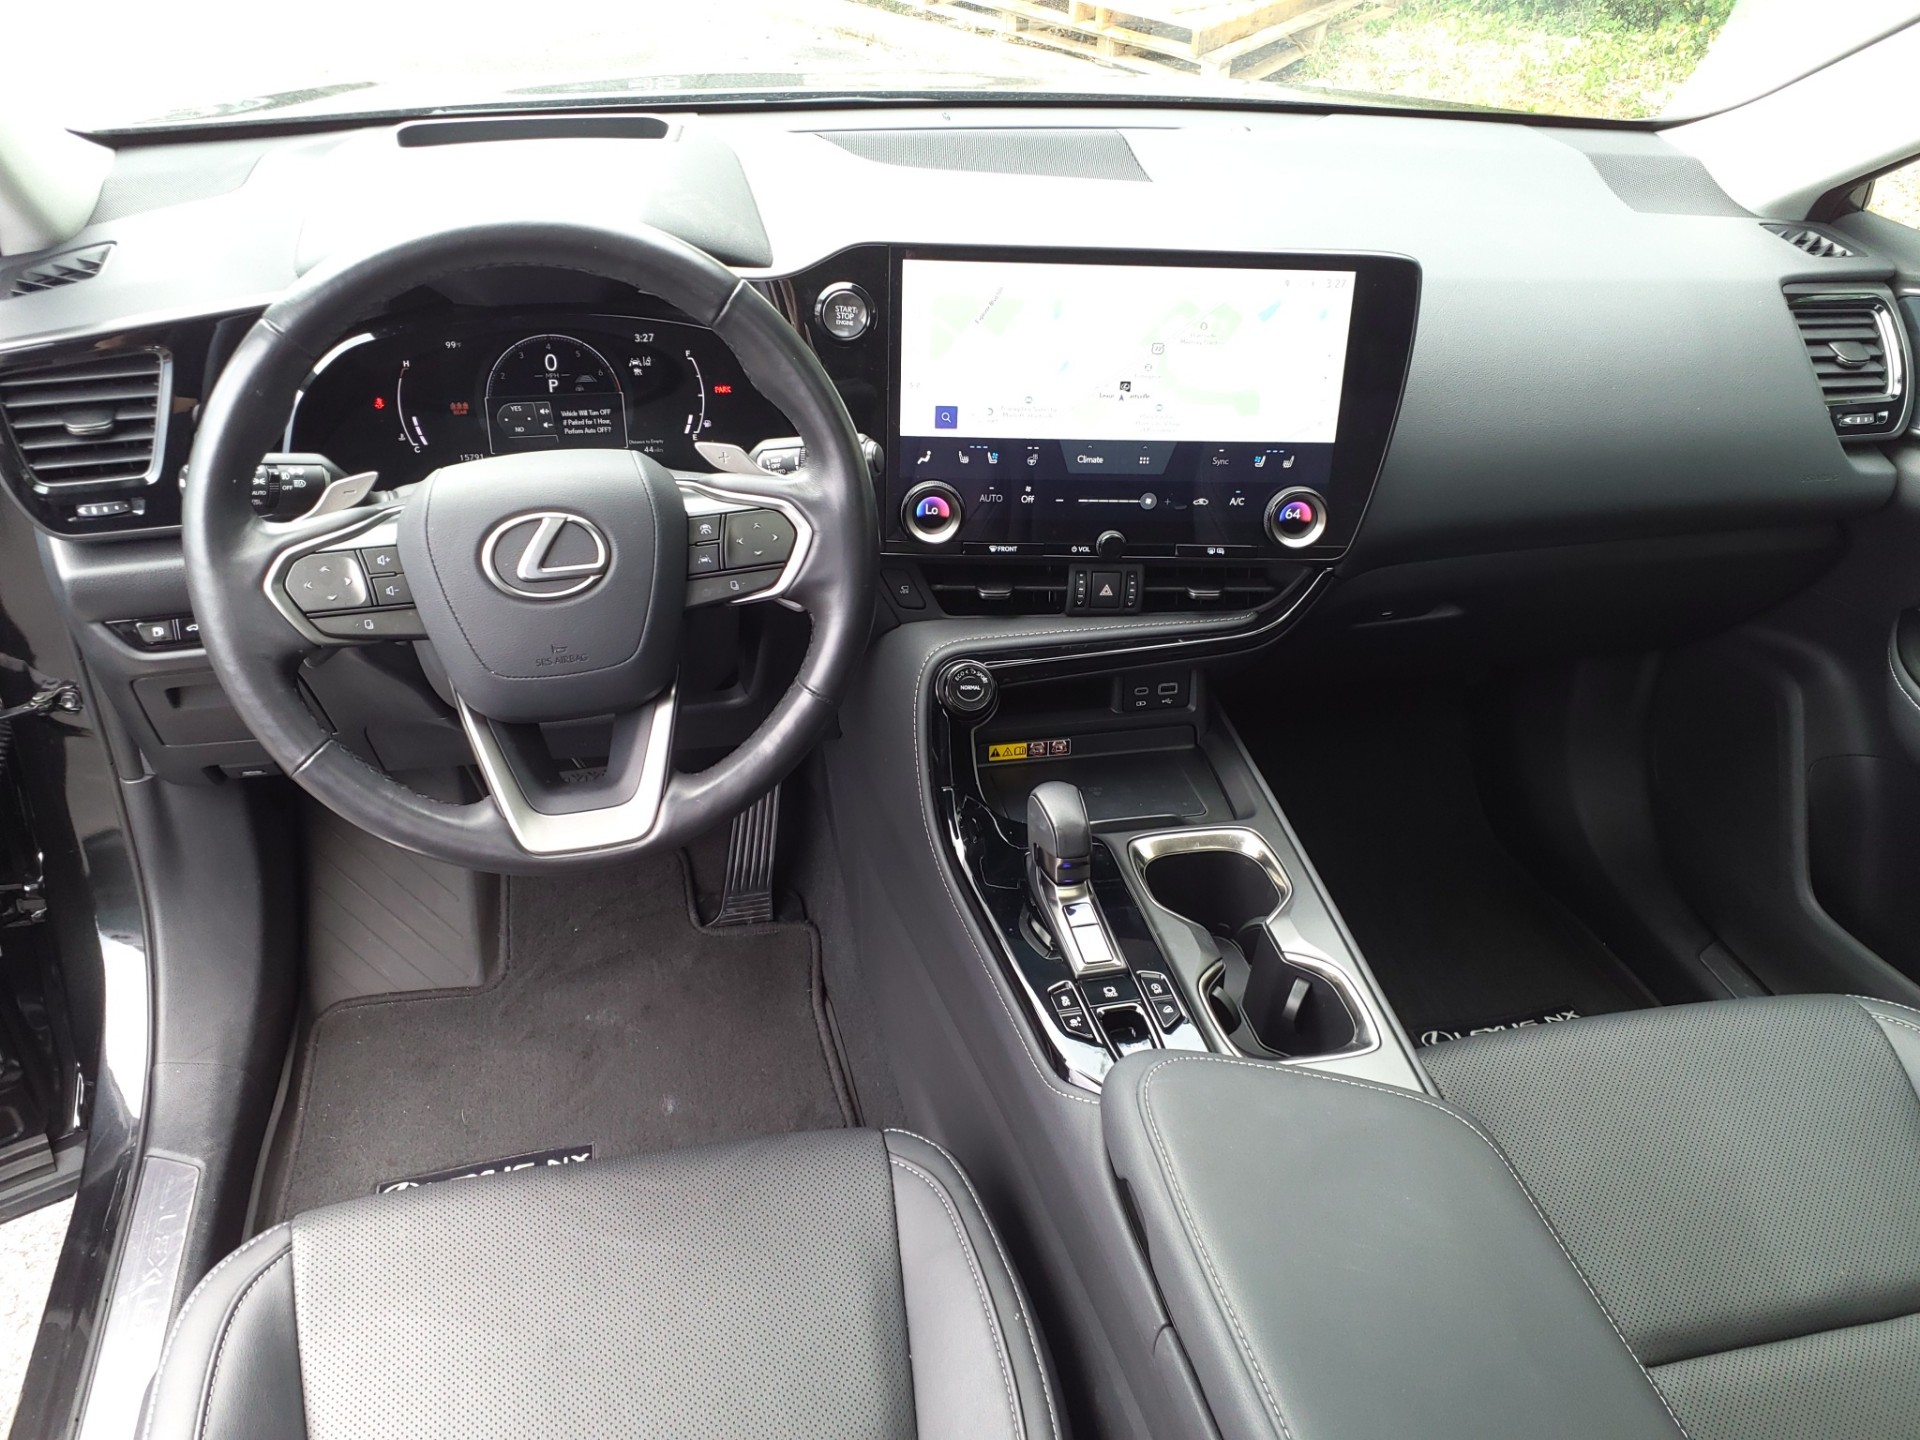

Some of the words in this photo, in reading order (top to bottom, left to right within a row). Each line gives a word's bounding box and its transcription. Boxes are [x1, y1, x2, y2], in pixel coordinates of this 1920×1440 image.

[834, 305, 857, 313] START
[634, 333, 654, 342] 3:27
[544, 354, 557, 372] 0
[548, 379, 558, 392] P
[714, 386, 732, 394] PARK
[1076, 455, 1104, 465] Climate
[1211, 457, 1230, 468] Sync
[979, 494, 1004, 503] AUTO
[1020, 494, 1035, 504] Off
[1229, 497, 1246, 506] A/C
[924, 504, 940, 516] Lo
[1284, 508, 1300, 520] 64
[954, 670, 965, 682] ECO
